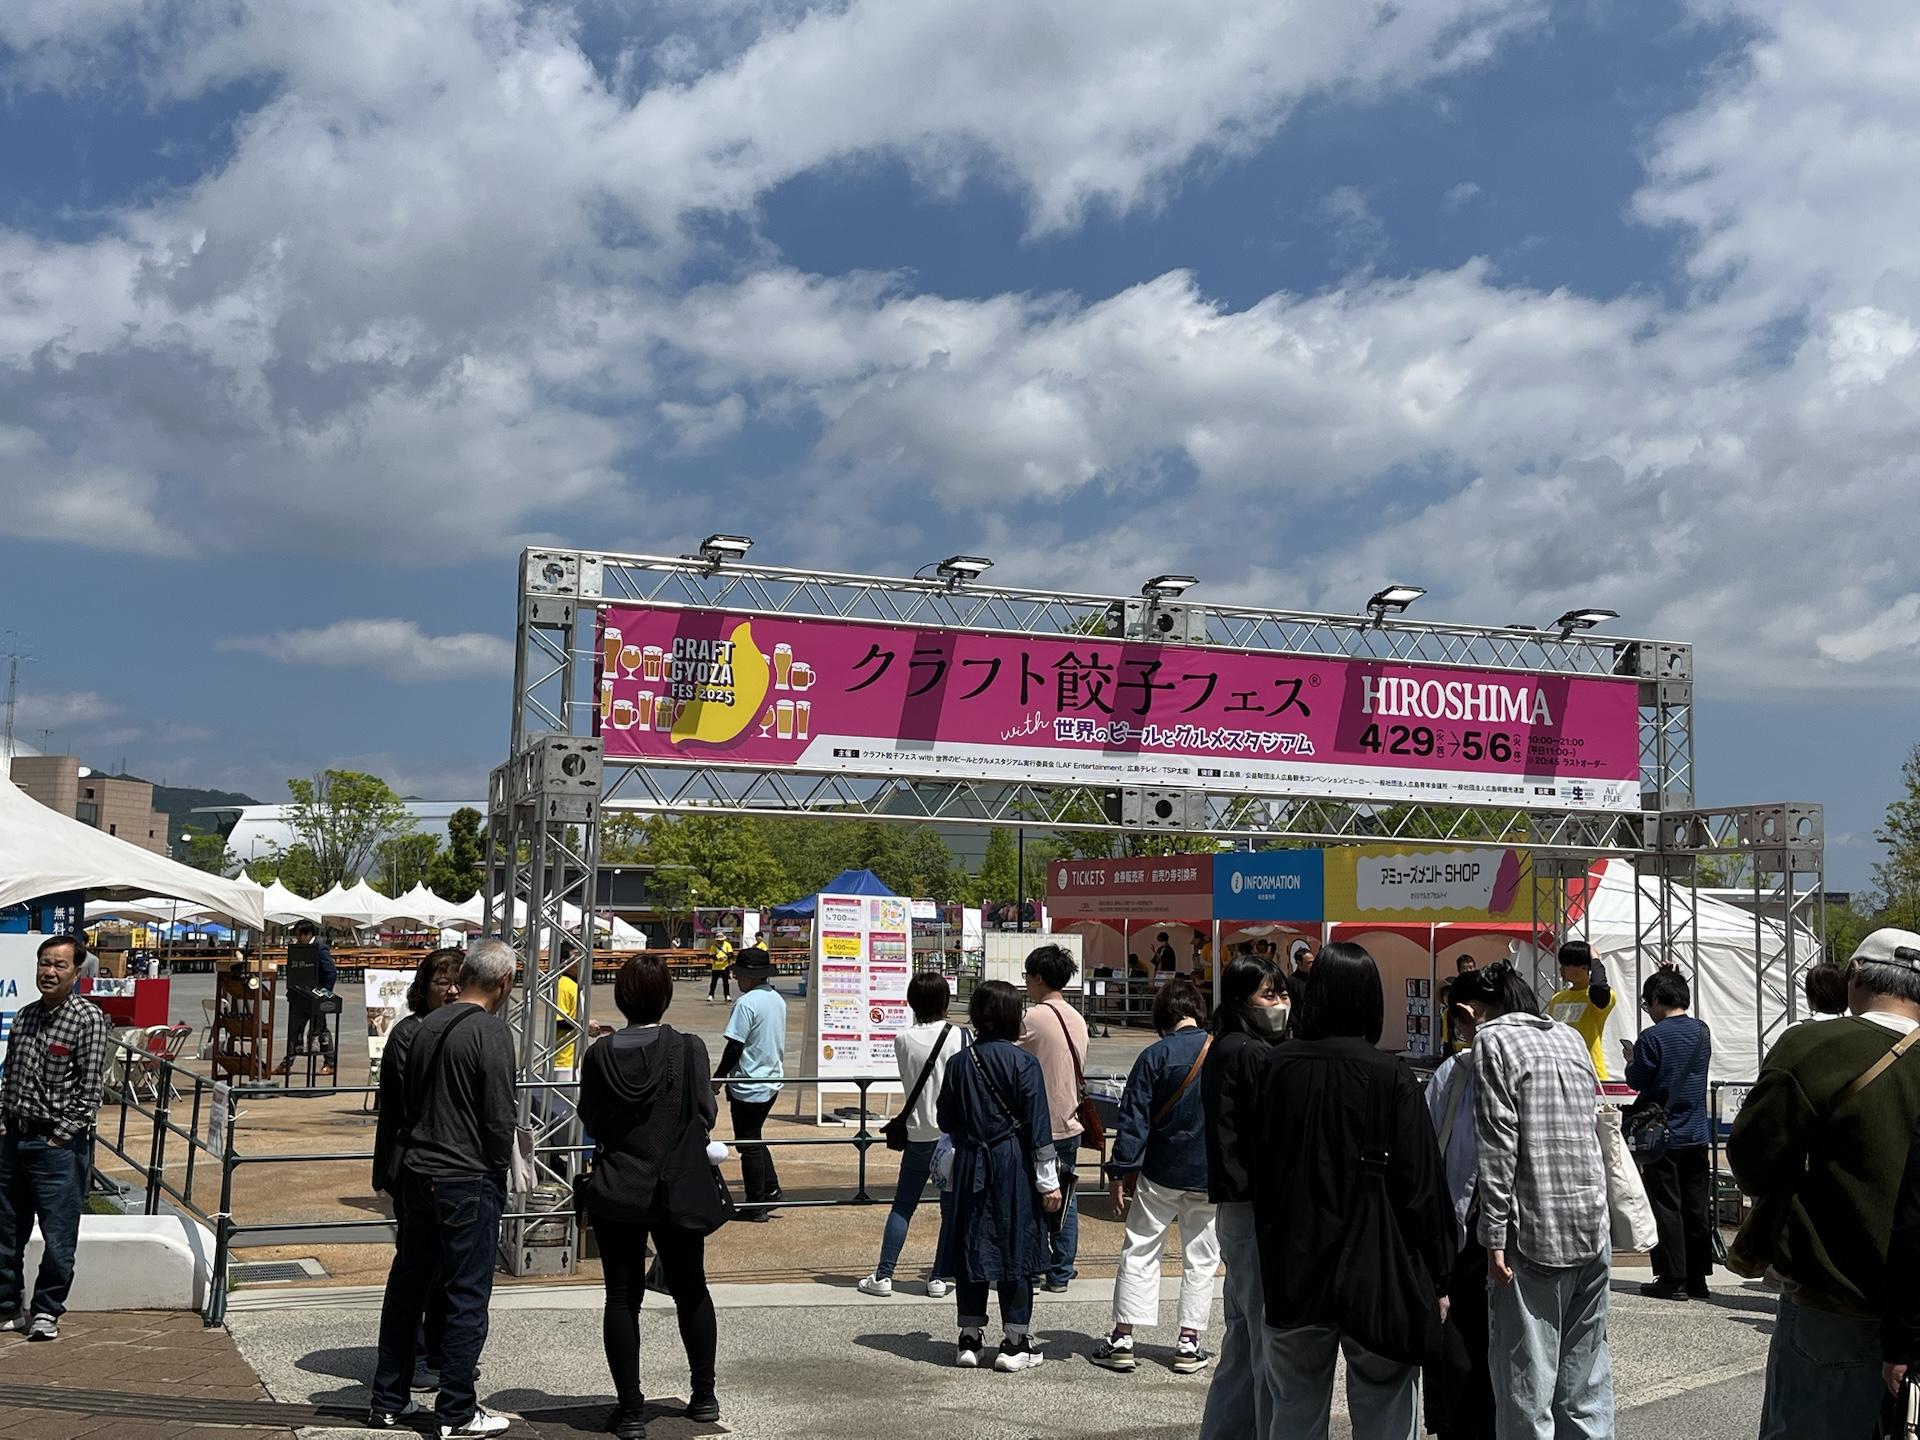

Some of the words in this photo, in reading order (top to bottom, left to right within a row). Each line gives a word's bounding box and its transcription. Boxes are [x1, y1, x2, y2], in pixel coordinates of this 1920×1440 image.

[672, 637, 735, 662] CRAFT
[671, 660, 735, 687] GYOZA
[671, 684, 694, 699] FES
[699, 688, 735, 705] 2025
[1361, 675, 1553, 726] HIROSHIMA
[1001, 711, 1049, 741] with
[1054, 717, 1315, 755] 世界のビールとグルメスタジアム
[1359, 724, 1434, 756] 4/29
[1462, 731, 1512, 762] 5/6
[1072, 870, 1105, 886] TICKETS
[1244, 875, 1301, 890] INFORMATION
[1381, 865, 1442, 885] アミューズメント
[1445, 863, 1480, 882] SHOP
